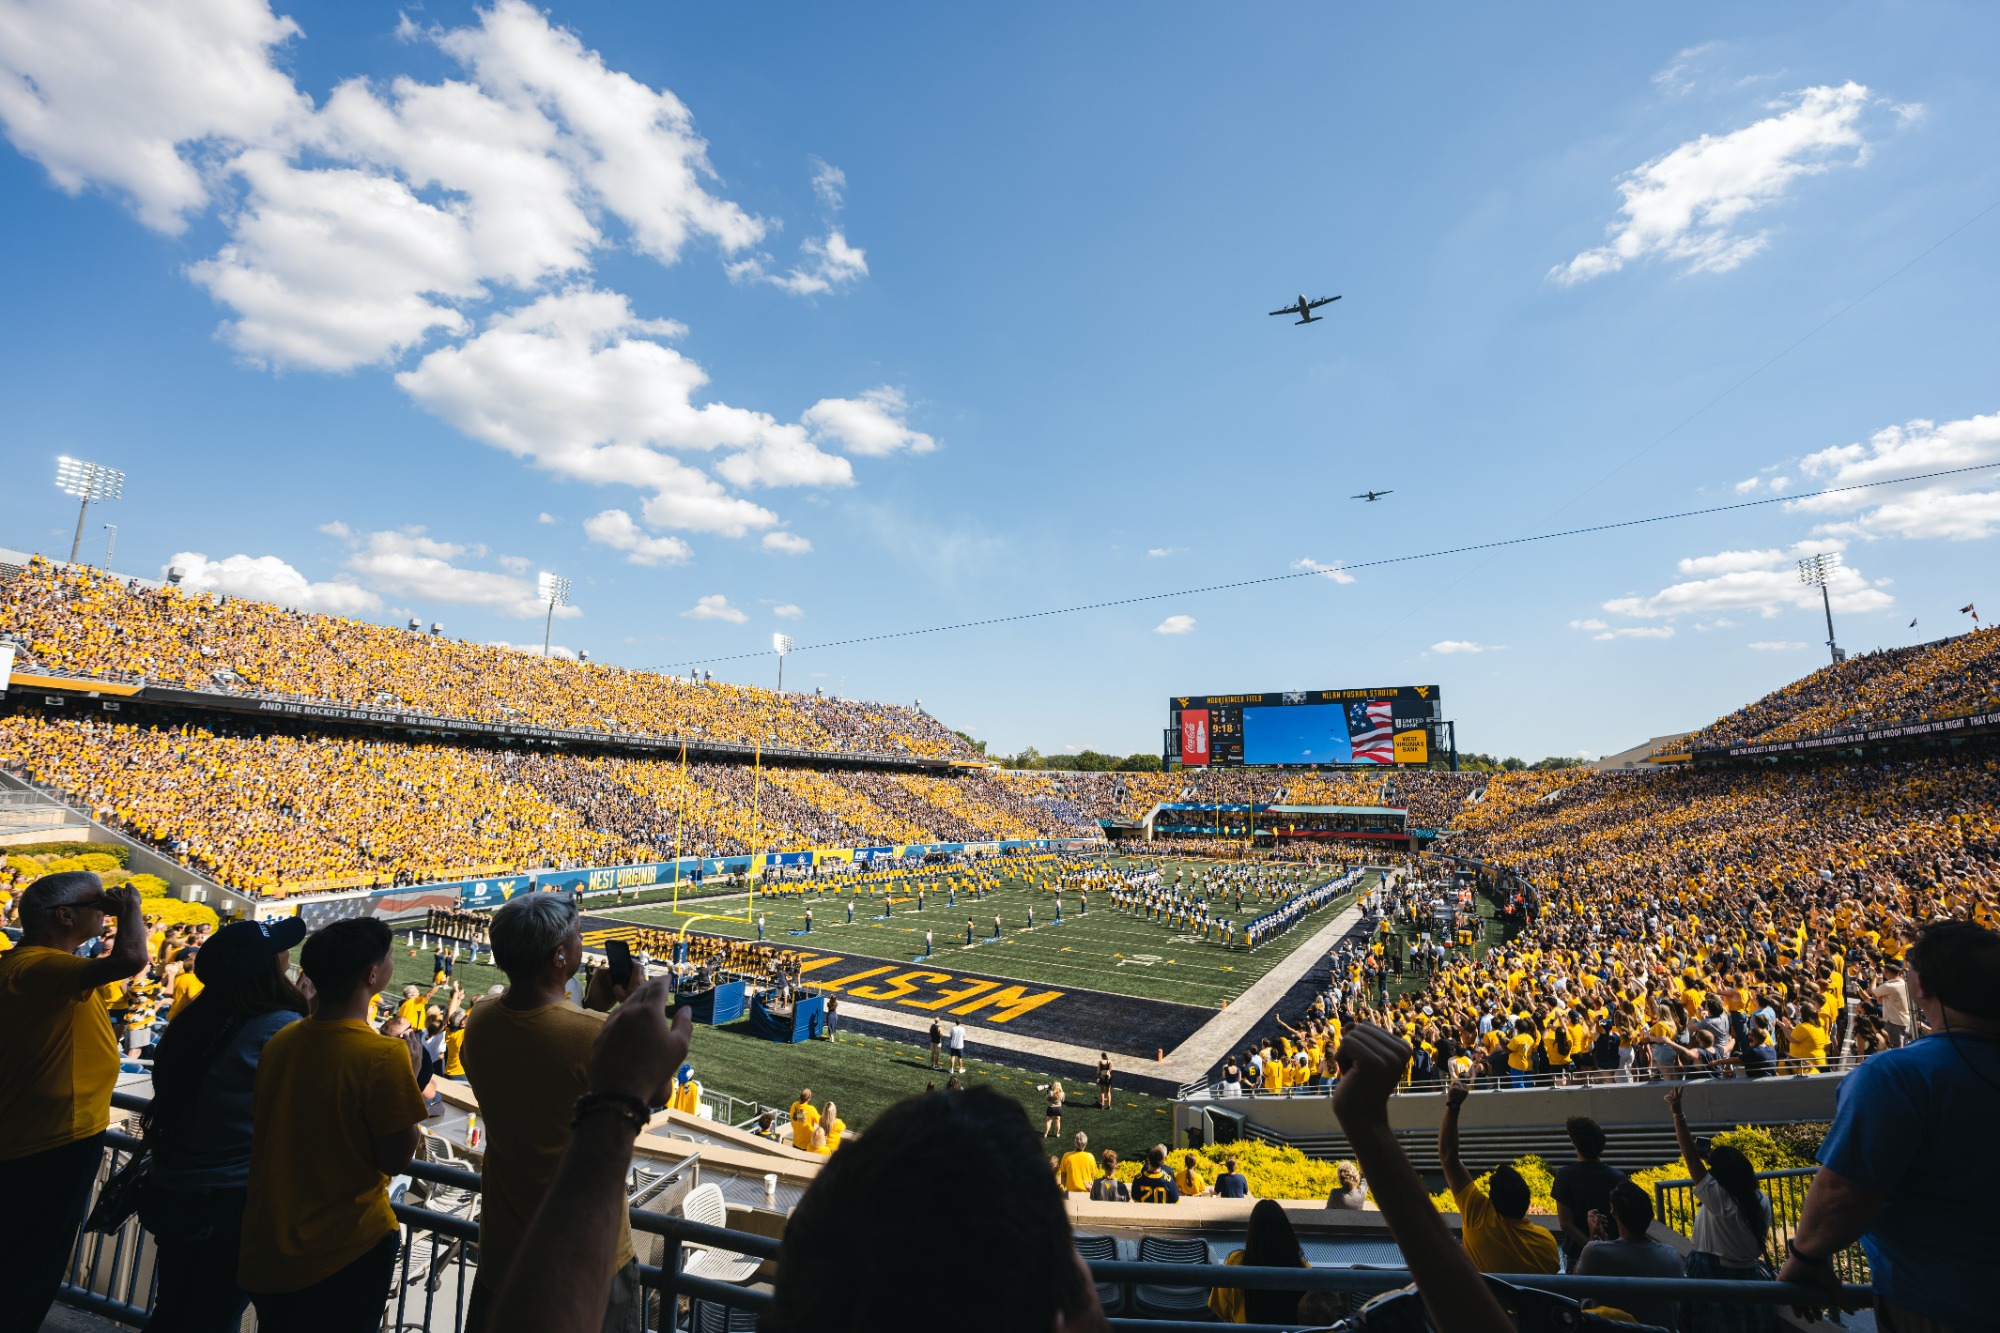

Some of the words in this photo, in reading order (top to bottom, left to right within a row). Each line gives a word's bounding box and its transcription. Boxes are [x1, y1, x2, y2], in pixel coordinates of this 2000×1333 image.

[1370, 689, 1398, 697] STADIUM
[260, 702, 281, 711] AND
[284, 704, 302, 713] THE
[304, 706, 348, 717] ROCKET'S
[350, 711, 367, 719] RED
[370, 713, 396, 722] GLARE
[419, 718, 445, 727] BOMBS
[448, 721, 482, 731] BURSTING
[551, 731, 579, 739] THROUGH
[1868, 731, 1882, 740] GAVE
[1883, 728, 1902, 738] PROOF
[1902, 724, 1931, 736] THROUGH
[1932, 722, 1944, 731] THE
[1944, 719, 1964, 730] NIGHT
[1969, 715, 1986, 726] THAT
[588, 870, 615, 890] WEST
[617, 866, 656, 886] VIRGINIA
[800, 966, 1066, 1024] WEST
[1140, 1186, 1166, 1204] 20
